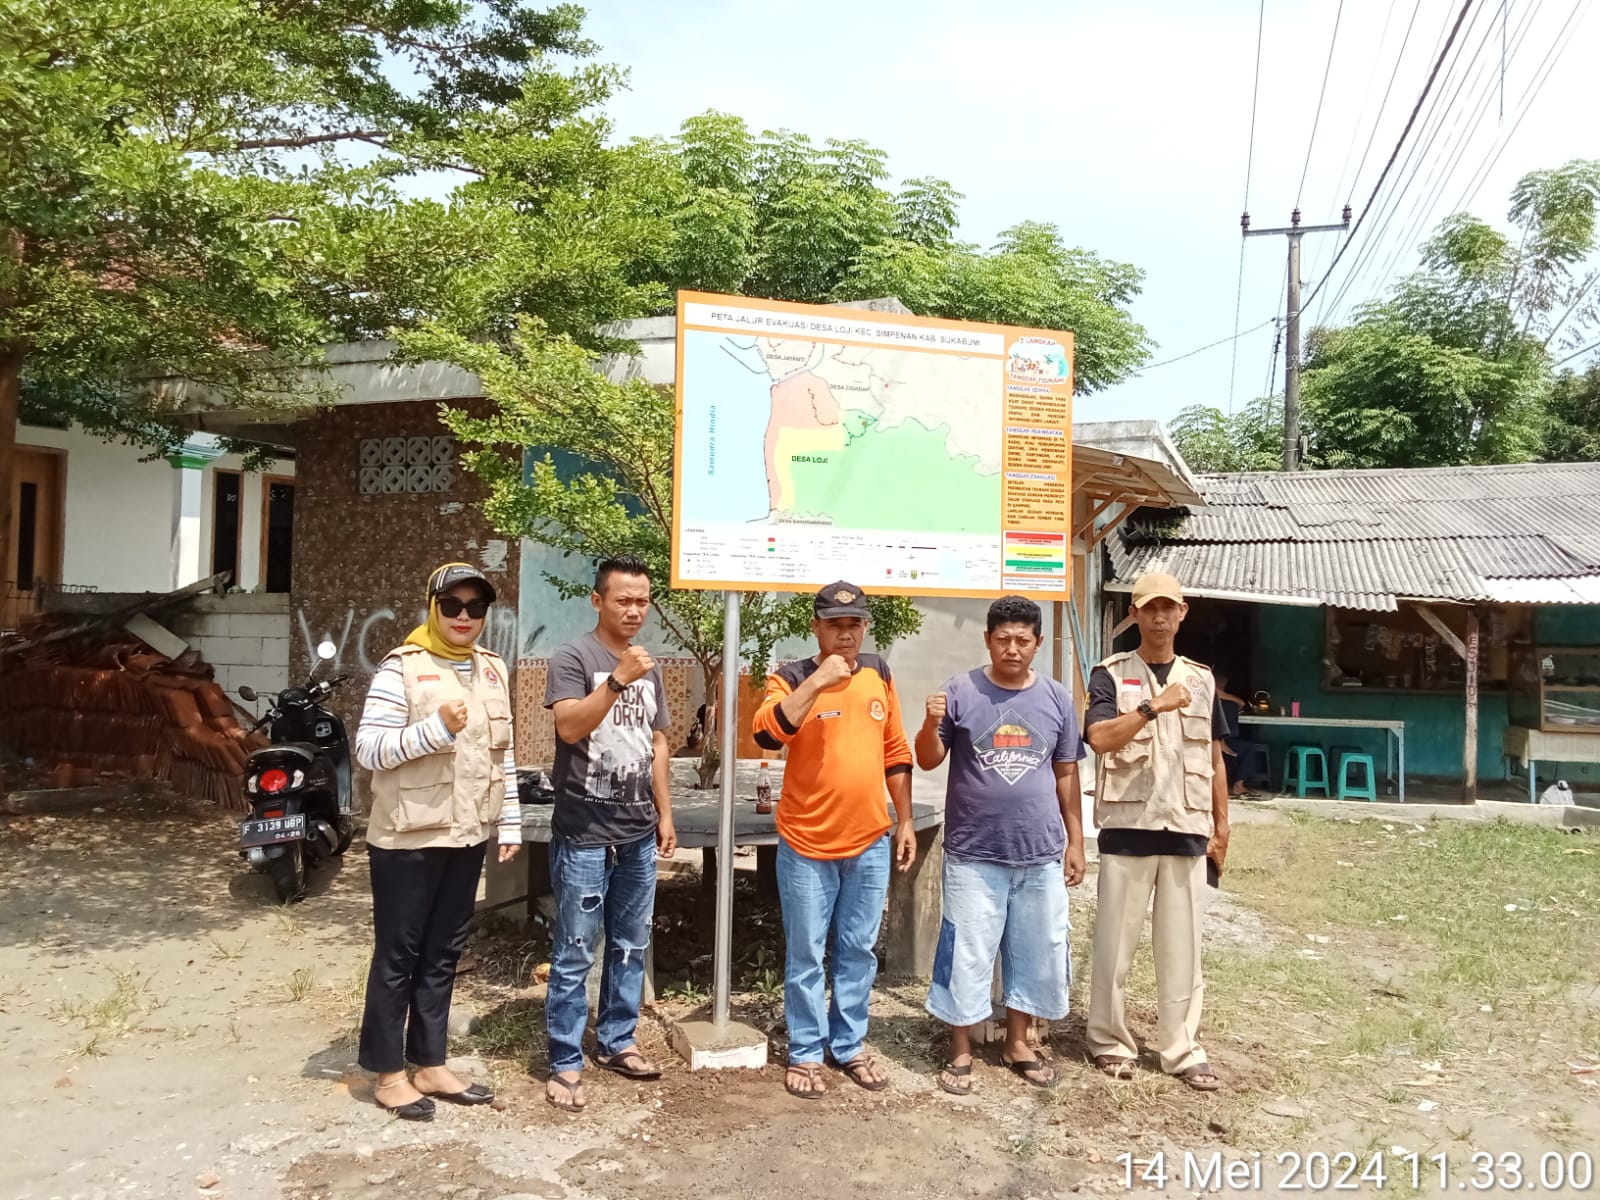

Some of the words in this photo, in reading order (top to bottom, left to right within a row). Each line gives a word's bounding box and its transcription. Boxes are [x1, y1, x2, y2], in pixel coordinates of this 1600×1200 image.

[711, 312, 733, 321] PETA
[735, 315, 763, 325] JALUR
[766, 318, 808, 330] EVAKUASI
[810, 323, 833, 332] DESA
[834, 326, 853, 334] LOJI
[876, 329, 917, 341] SIMPENAN
[940, 336, 980, 347] SUKABUMI
[766, 353, 782, 361] DESA
[829, 383, 845, 391] DESA
[709, 405, 717, 434] Hindia
[708, 437, 717, 476] Samudra
[791, 455, 811, 463] DESA
[618, 684, 646, 707] OCK
[980, 750, 1041, 769] California
[244, 825, 251, 834] F
[257, 820, 281, 833] 3139
